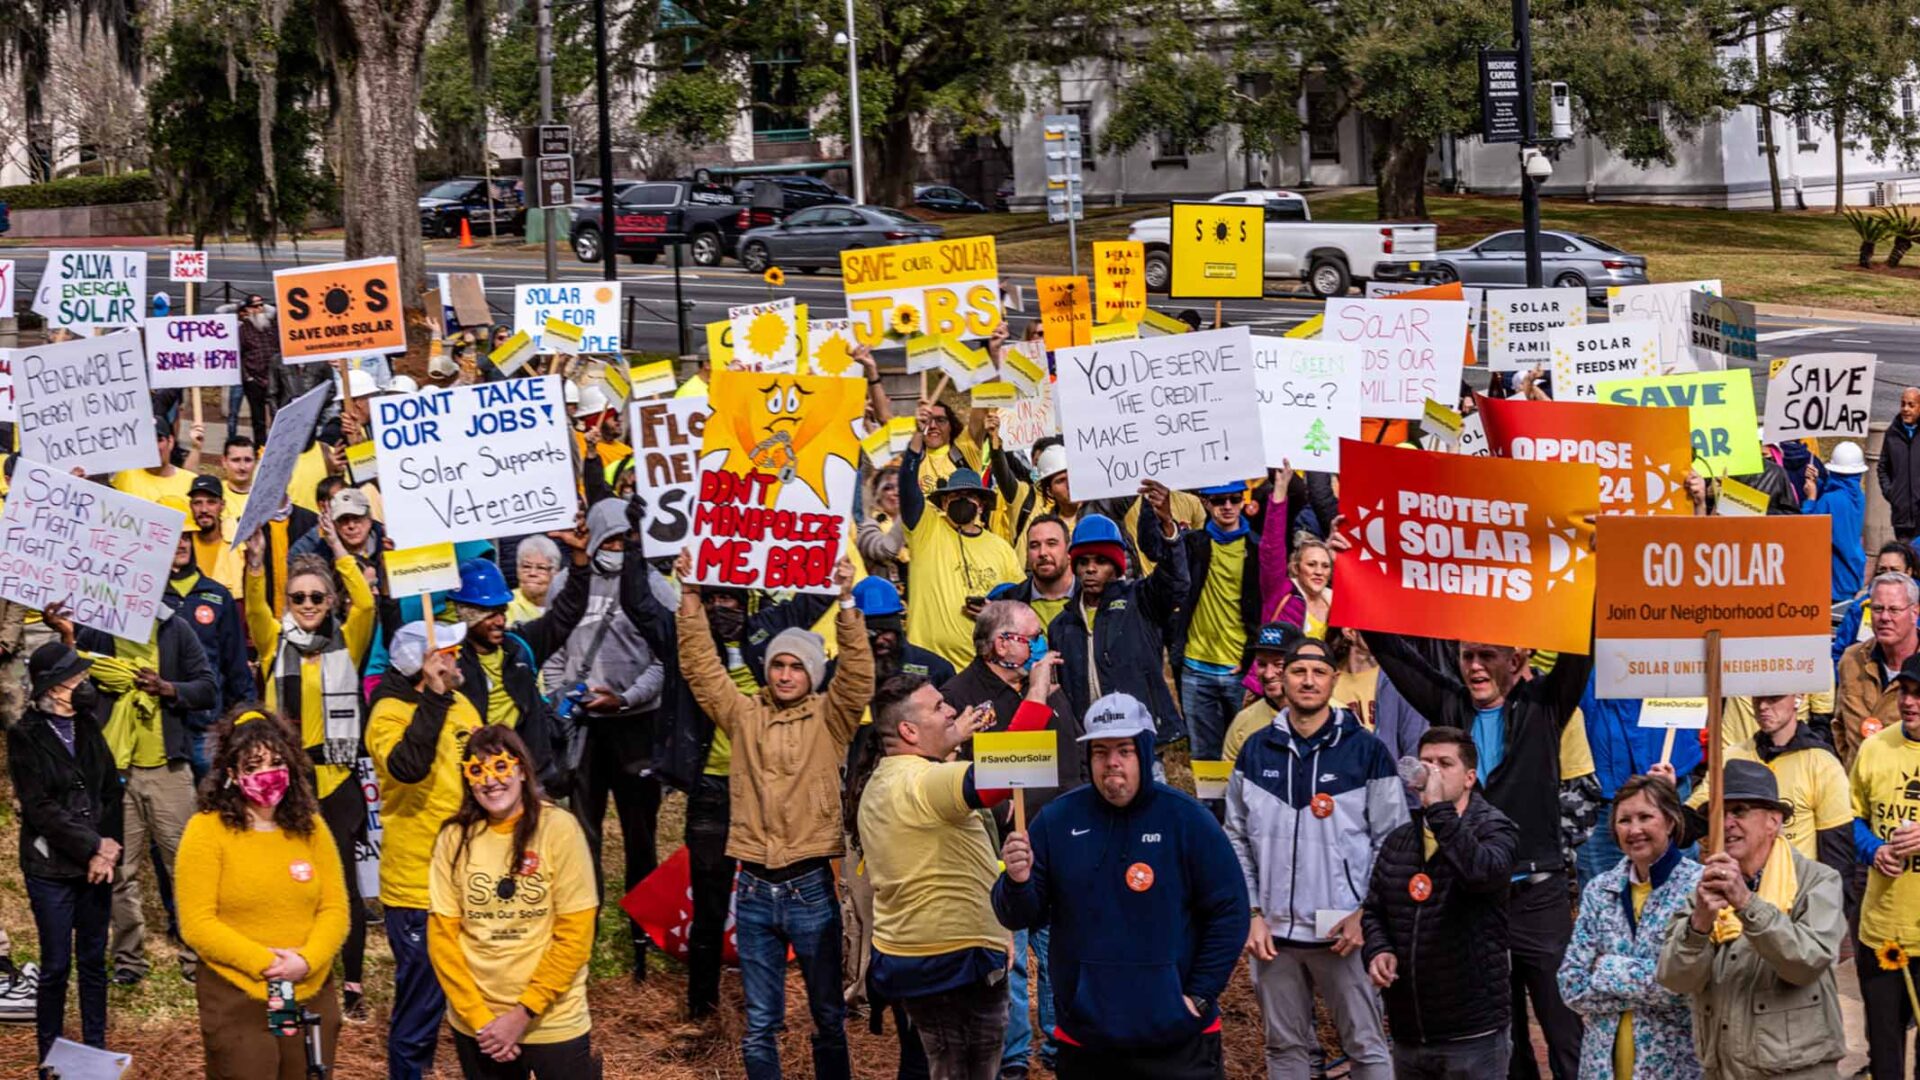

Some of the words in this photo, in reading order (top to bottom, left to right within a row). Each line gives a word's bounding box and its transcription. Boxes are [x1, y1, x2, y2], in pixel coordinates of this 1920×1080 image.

[61, 254, 113, 279] SALVA
[175, 252, 204, 265] SAVE
[175, 267, 205, 278] SOLAR
[845, 252, 897, 285] SAVE
[902, 255, 933, 272] OUR
[939, 241, 995, 274] SOLAR
[525, 287, 580, 305] SOLAR
[1510, 302, 1560, 313] SOLAR
[58, 298, 138, 325] SOLAR
[536, 309, 550, 325] IS
[563, 309, 595, 325] FOR
[1337, 304, 1432, 344] SOLAR
[289, 327, 322, 341] SAVE
[324, 325, 350, 338] OUR
[352, 320, 393, 335] SOLAR
[1508, 321, 1545, 333] FEEDS
[1691, 312, 1721, 332] SAVE
[1721, 321, 1757, 341] SOLAR
[1691, 331, 1720, 350] SAVE
[1577, 337, 1631, 352] SOLAR
[1073, 351, 1127, 395] YOU
[1131, 345, 1241, 383] DESERVE
[1399, 348, 1436, 371] OUR
[1576, 360, 1616, 374] FEEDS
[1618, 358, 1638, 370] MY
[23, 350, 138, 399] RENEWABLE
[1786, 365, 1867, 396] SAVE
[380, 391, 453, 426] DONT
[472, 378, 546, 409] TAKE
[1109, 389, 1145, 415] THE
[1361, 377, 1437, 404] MILIES
[1610, 382, 1727, 408] SAVE
[20, 400, 73, 432] ENERGY
[82, 393, 101, 417] IS
[105, 390, 138, 413] NOT
[1778, 396, 1868, 434] SOLAR
[75, 418, 139, 456] ENEMY
[382, 421, 441, 450] OUR
[465, 404, 554, 438] JOBS!
[1077, 422, 1139, 452] MAKE
[1155, 410, 1210, 436] SURE
[399, 455, 469, 490] Solar
[478, 441, 567, 478] Supports
[1097, 455, 1139, 488] YOU
[1143, 449, 1186, 476] GET
[1201, 429, 1229, 462] IT!
[1511, 436, 1633, 470] OPPOSE
[1599, 475, 1634, 504] 24
[24, 469, 95, 521] SOLAR
[100, 500, 143, 536] WON
[148, 521, 172, 545] THE
[424, 486, 558, 529] Veterans
[1398, 489, 1529, 527] PROTECT
[89, 528, 119, 557] THE
[1399, 520, 1532, 564] SOLAR
[62, 546, 128, 587] SOLAR
[132, 574, 153, 593] IS
[764, 539, 839, 589] BRO!
[1642, 542, 1684, 587] GO
[1693, 542, 1786, 587] SOLAR
[0, 552, 54, 585] GOING
[62, 572, 79, 591] TO
[83, 578, 119, 606] WIN
[123, 594, 153, 618] THIS
[1401, 558, 1532, 602] RIGHTS
[1, 576, 55, 604] FIGHT
[60, 591, 129, 633] AGAIN
[1606, 604, 1637, 621] Join
[1639, 604, 1667, 621] Our
[1671, 603, 1774, 625] Neighborhood
[1777, 602, 1820, 621] Co-op
[1628, 661, 1669, 675] SOLAR
[1648, 700, 1705, 709] #SaveOurSolar
[980, 754, 1052, 764] #SaveOurSolar
[1263, 769, 1280, 778] run
[1877, 803, 1918, 822] SAVE
[1141, 832, 1161, 843] run
[468, 910, 495, 920] Save
[498, 910, 516, 919] Our
[519, 908, 548, 919] Solar
